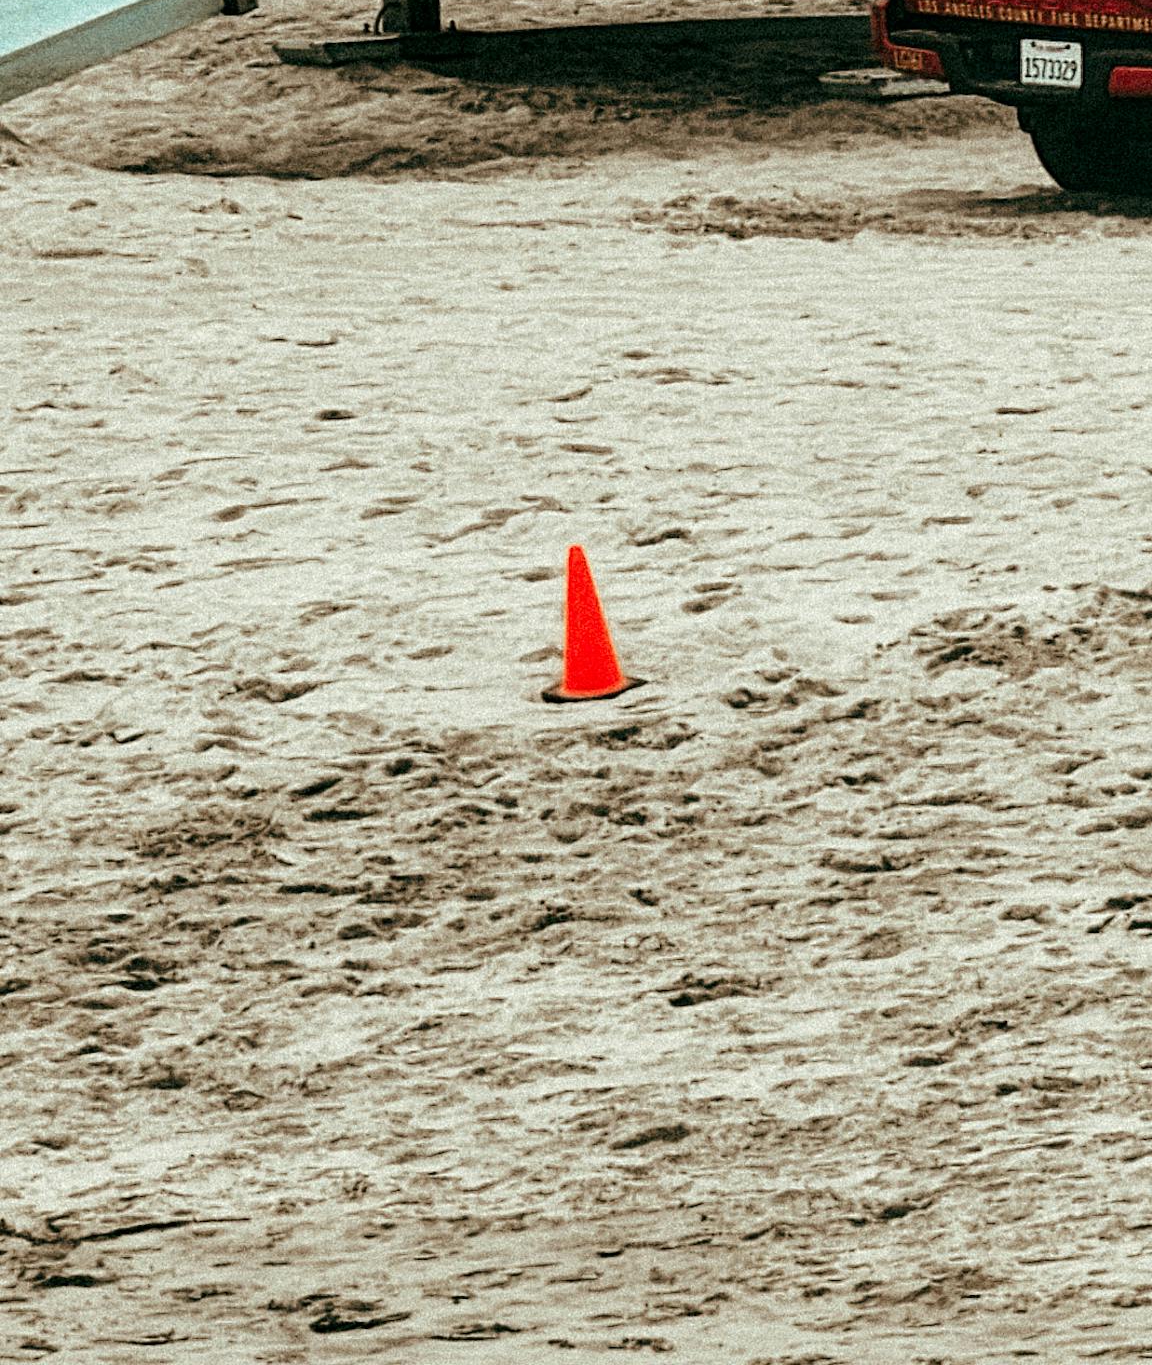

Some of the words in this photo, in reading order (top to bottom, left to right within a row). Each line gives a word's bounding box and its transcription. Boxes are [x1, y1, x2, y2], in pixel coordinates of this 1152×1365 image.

[918, 0, 938, 14] LOS
[944, 1, 993, 19] ANGELES
[1000, 6, 1043, 23] COUNTY
[1051, 10, 1078, 26] FIRE
